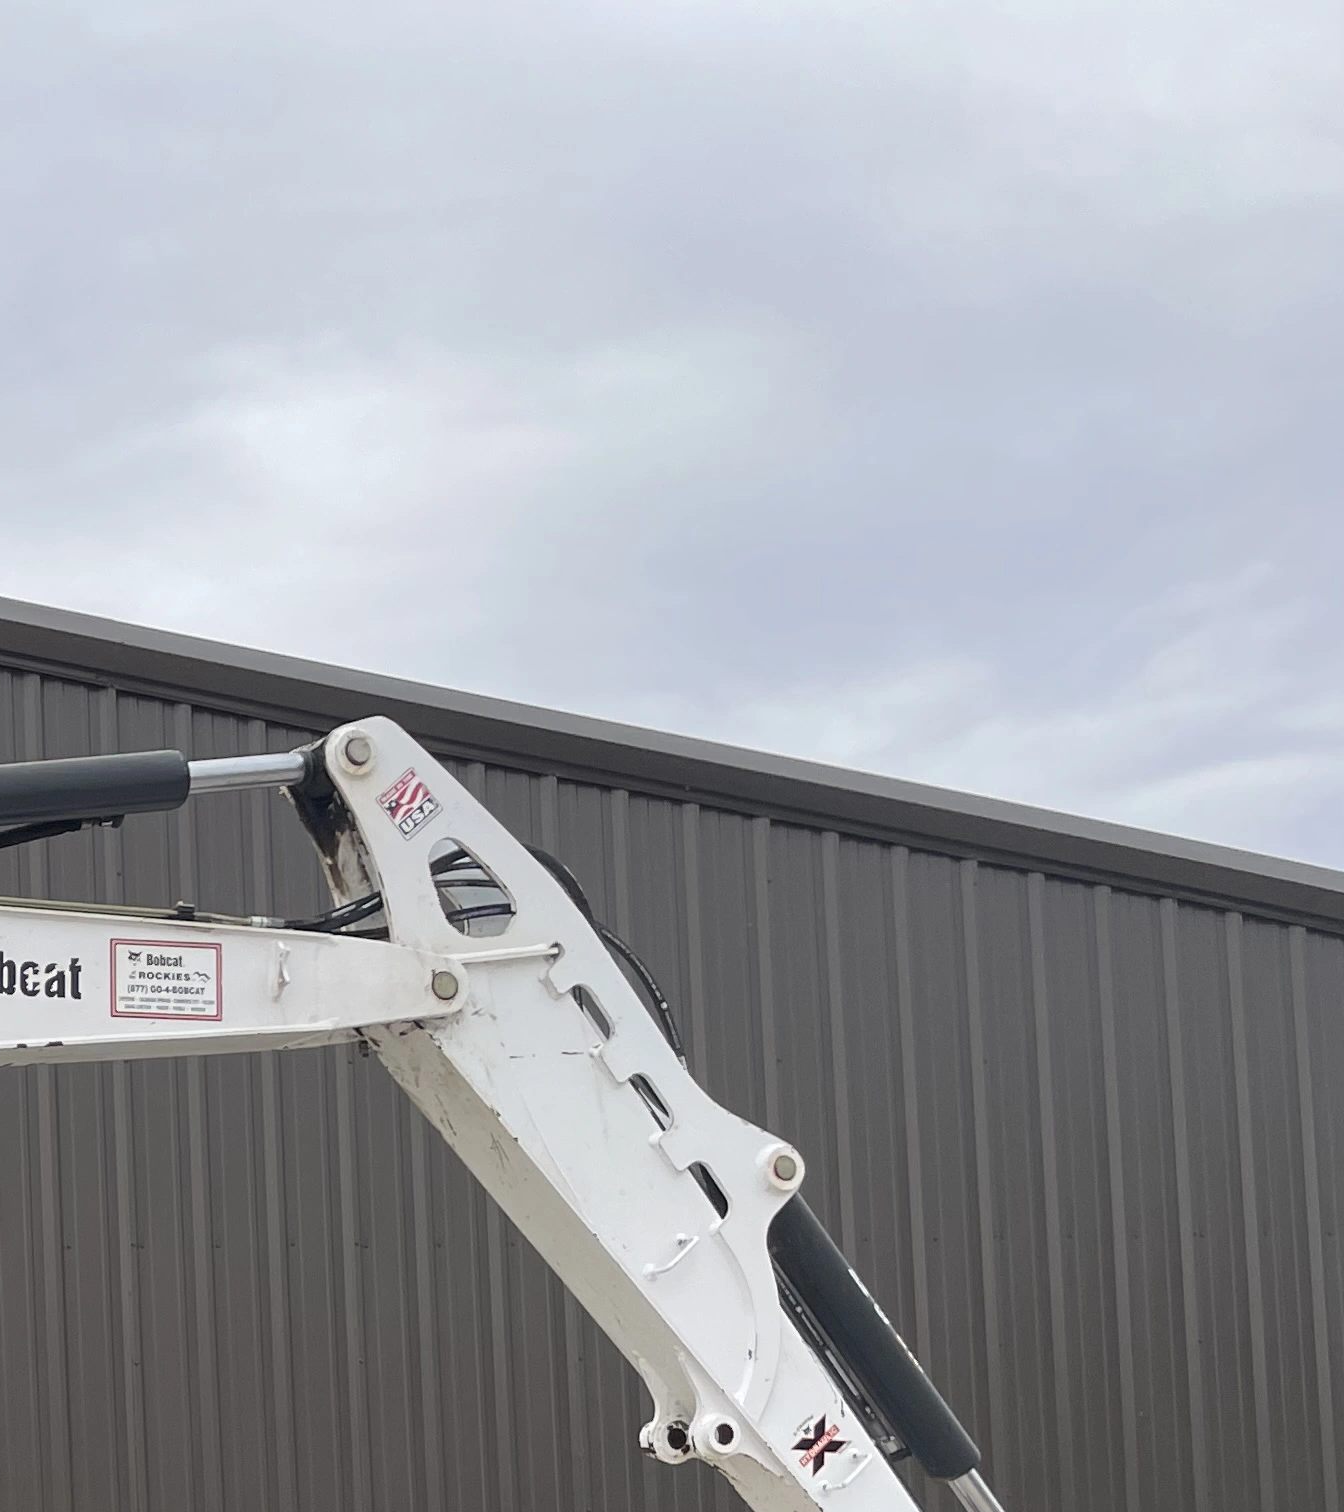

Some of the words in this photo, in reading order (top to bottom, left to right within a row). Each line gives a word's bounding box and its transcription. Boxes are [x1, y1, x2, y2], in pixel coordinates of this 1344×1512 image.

[399, 800, 435, 833] USA
[146, 953, 184, 967] Bobcat
[138, 971, 191, 981] ROCKIES
[127, 984, 148, 994] (877)
[150, 985, 206, 995] GO-4-BOBCAT
[800, 1425, 839, 1466] HYDRAULIC
